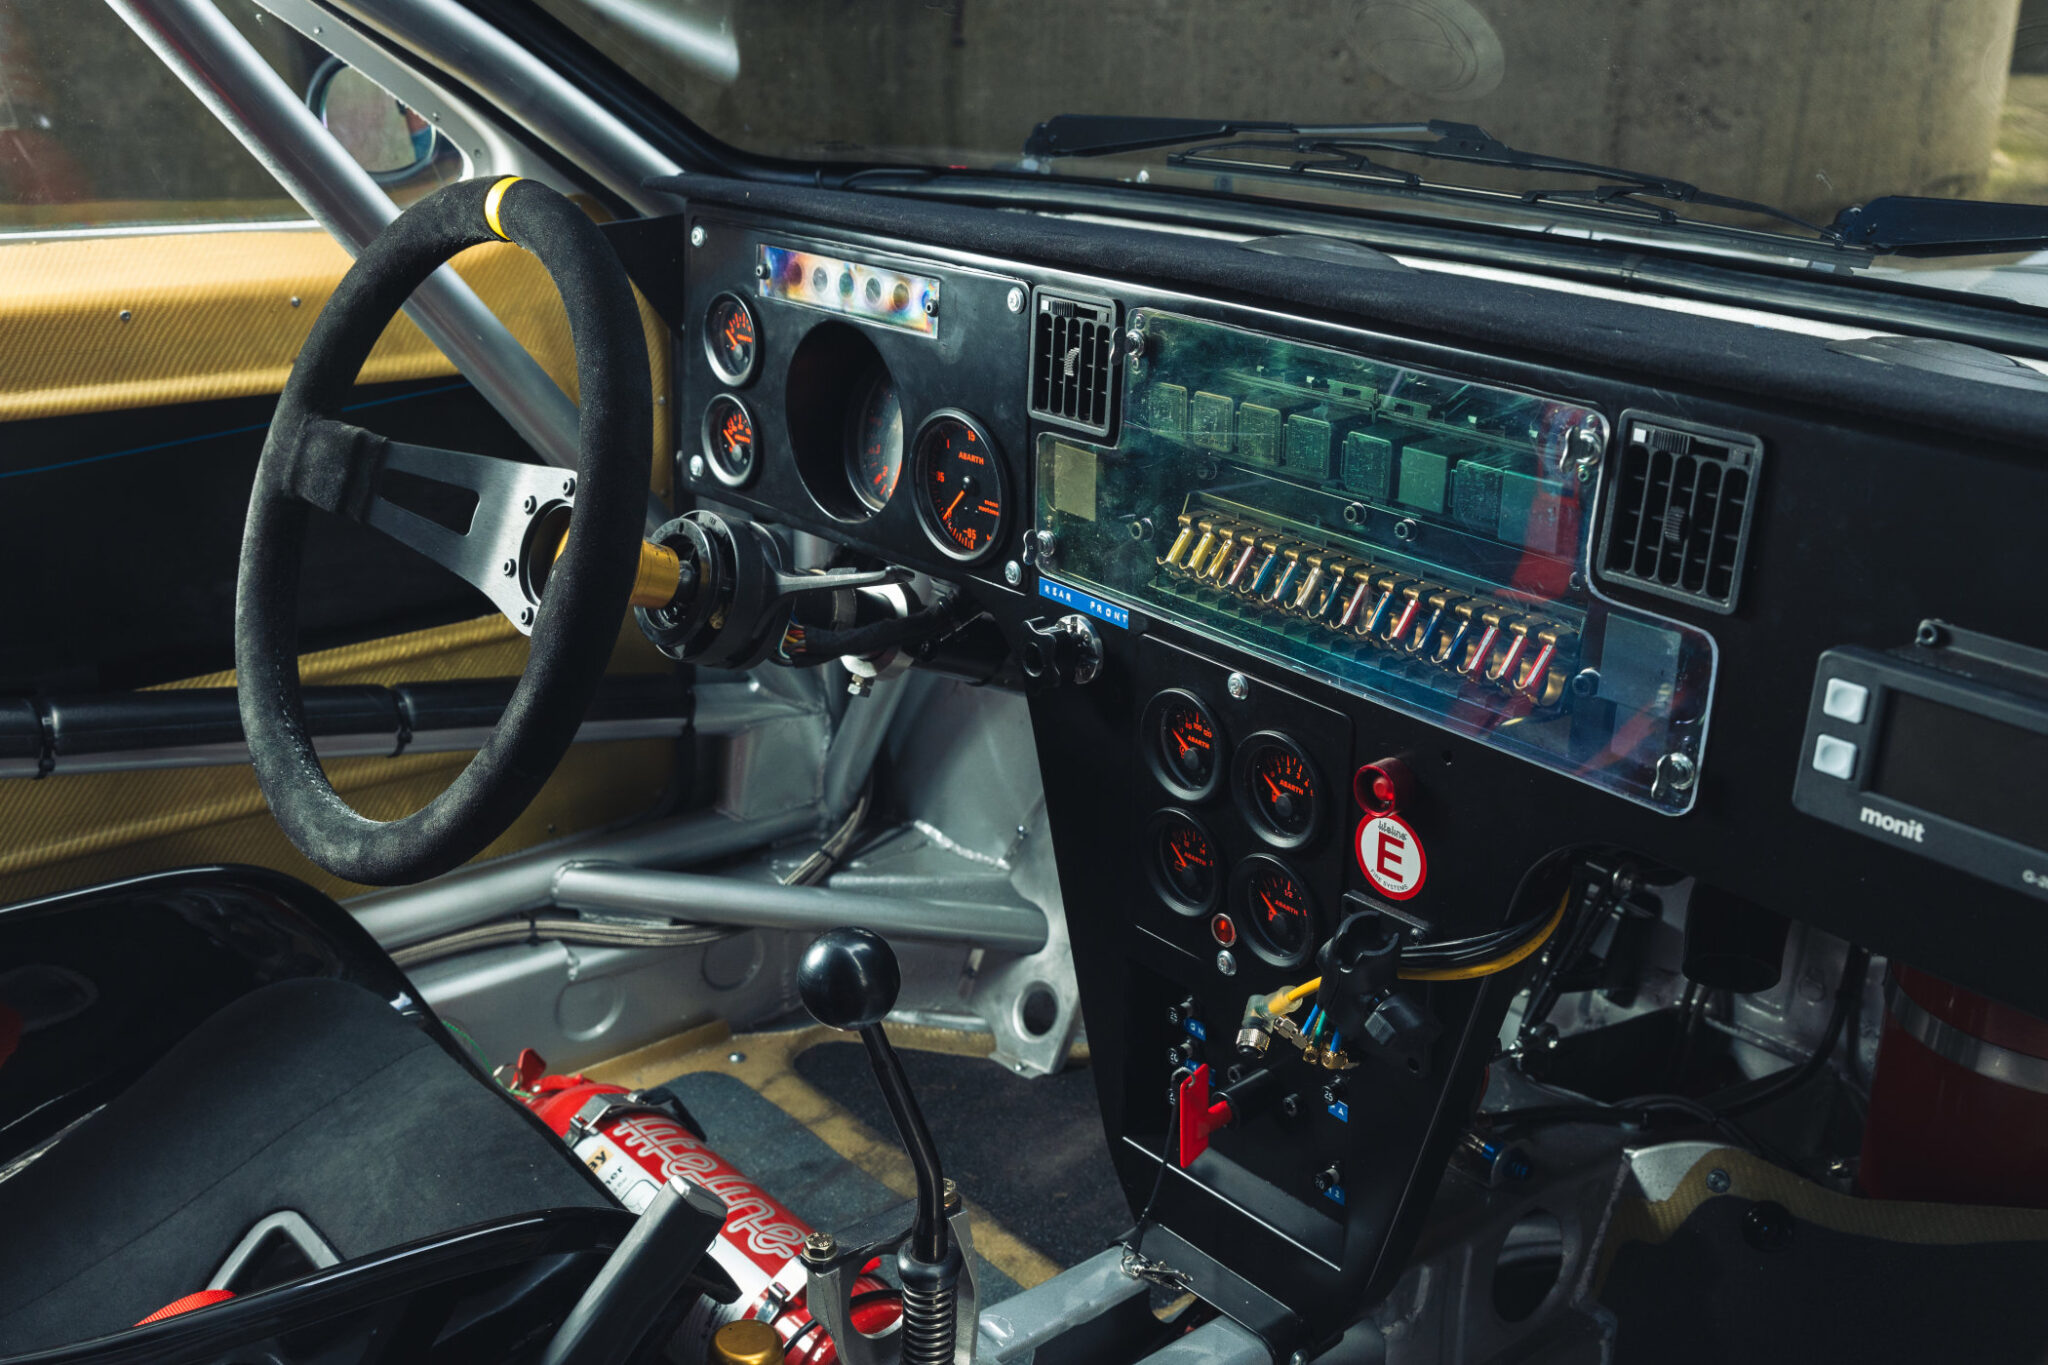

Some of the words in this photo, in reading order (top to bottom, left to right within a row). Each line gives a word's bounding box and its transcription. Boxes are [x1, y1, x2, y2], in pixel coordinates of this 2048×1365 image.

[958, 451, 985, 466] ABARTH
[1044, 584, 1072, 603] REAR
[1089, 600, 1129, 624] FRONT
[1187, 735, 1210, 750] ABARTH
[1279, 779, 1304, 796] ABARTH
[1860, 806, 1926, 843] monit
[1377, 831, 1405, 884] E
[1370, 868, 1383, 882] FIRE
